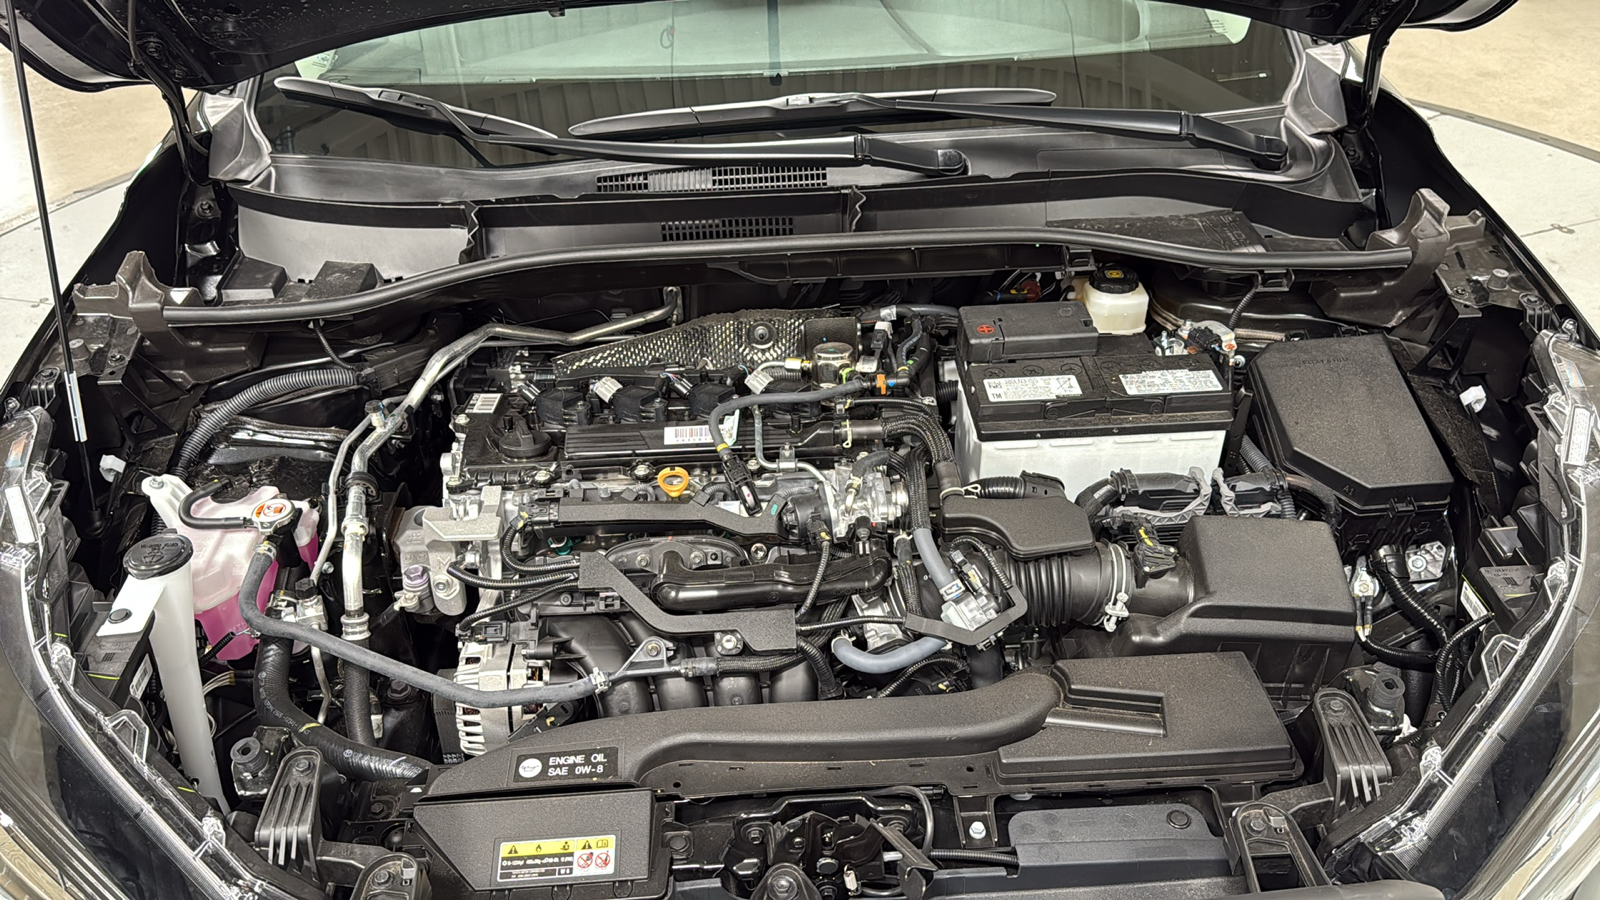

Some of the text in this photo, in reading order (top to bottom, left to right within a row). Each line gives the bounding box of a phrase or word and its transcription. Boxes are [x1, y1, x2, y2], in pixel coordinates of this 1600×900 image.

[1342, 484, 1354, 496] A1
[549, 753, 607, 765] ENGINE OIL
[548, 765, 603, 776] SAE 0W-8
